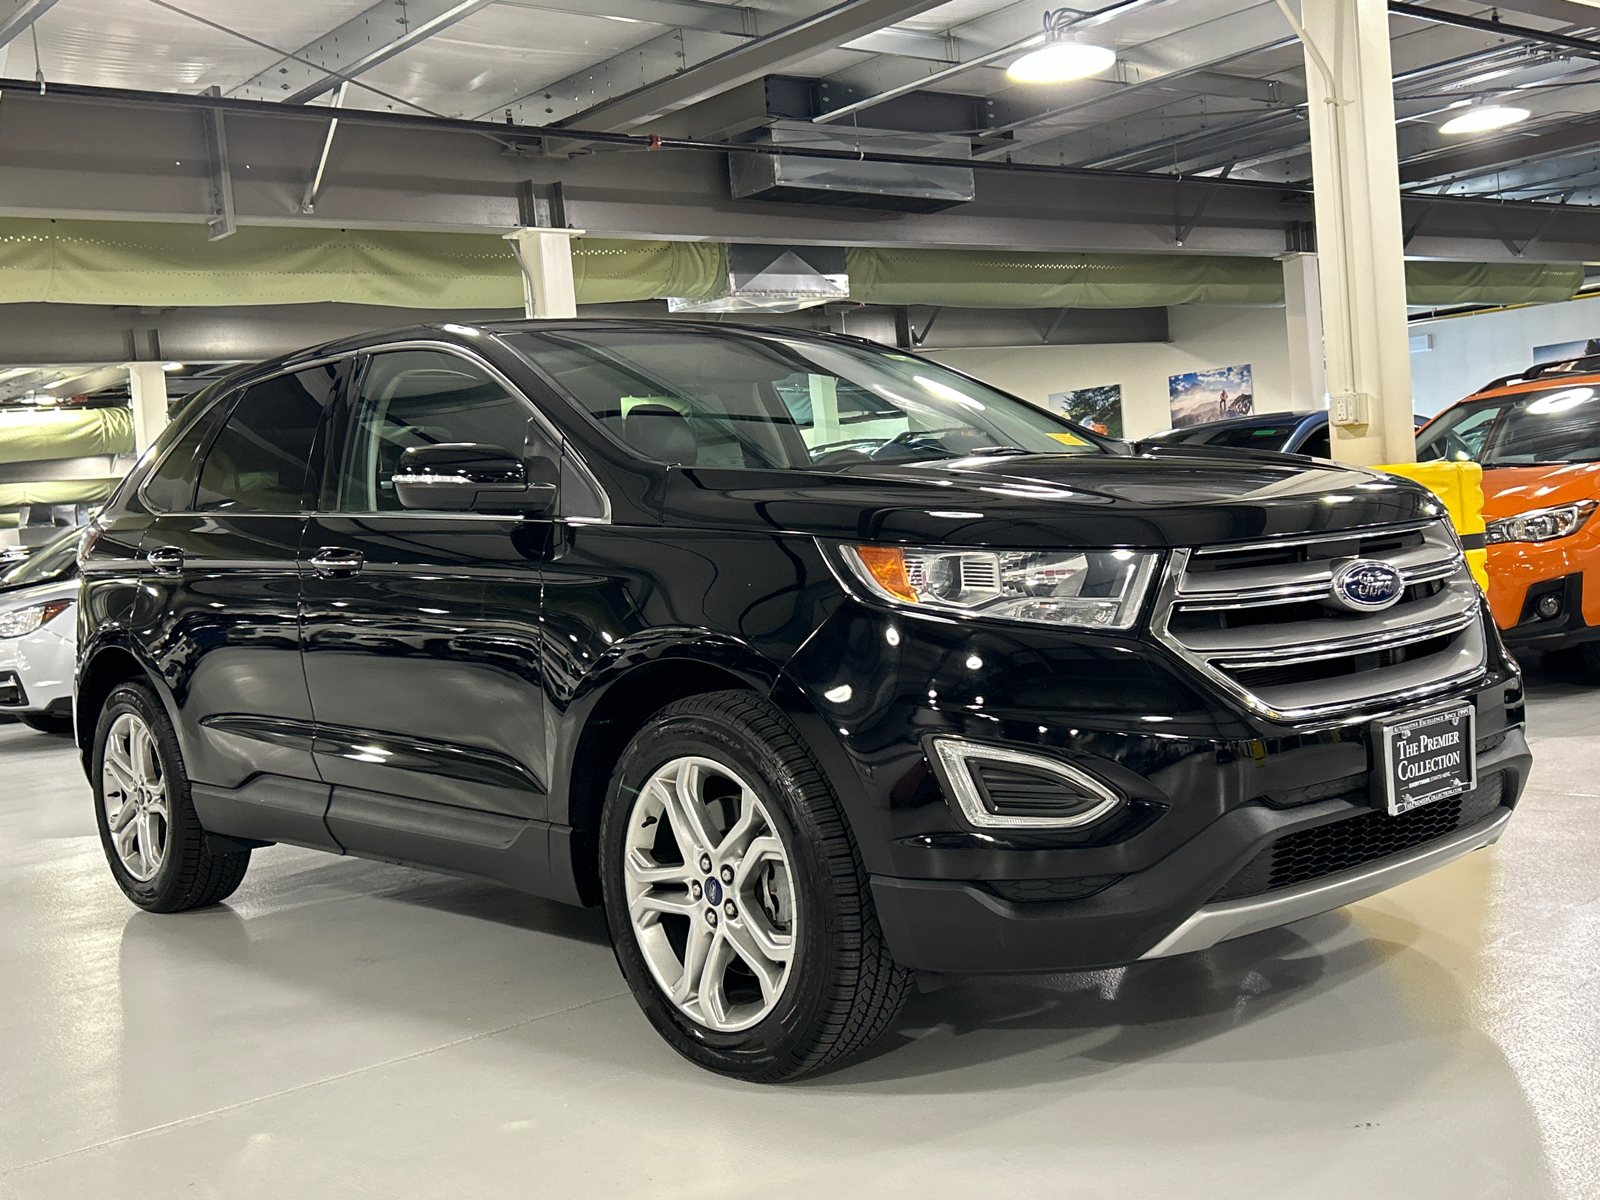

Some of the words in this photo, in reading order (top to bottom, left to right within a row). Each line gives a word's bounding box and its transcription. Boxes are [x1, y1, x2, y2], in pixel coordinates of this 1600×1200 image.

[1351, 570, 1394, 598] Ford
[1396, 740, 1419, 760] THE
[1419, 731, 1460, 753] PREMIER
[1397, 750, 1461, 781] COLLECTION
